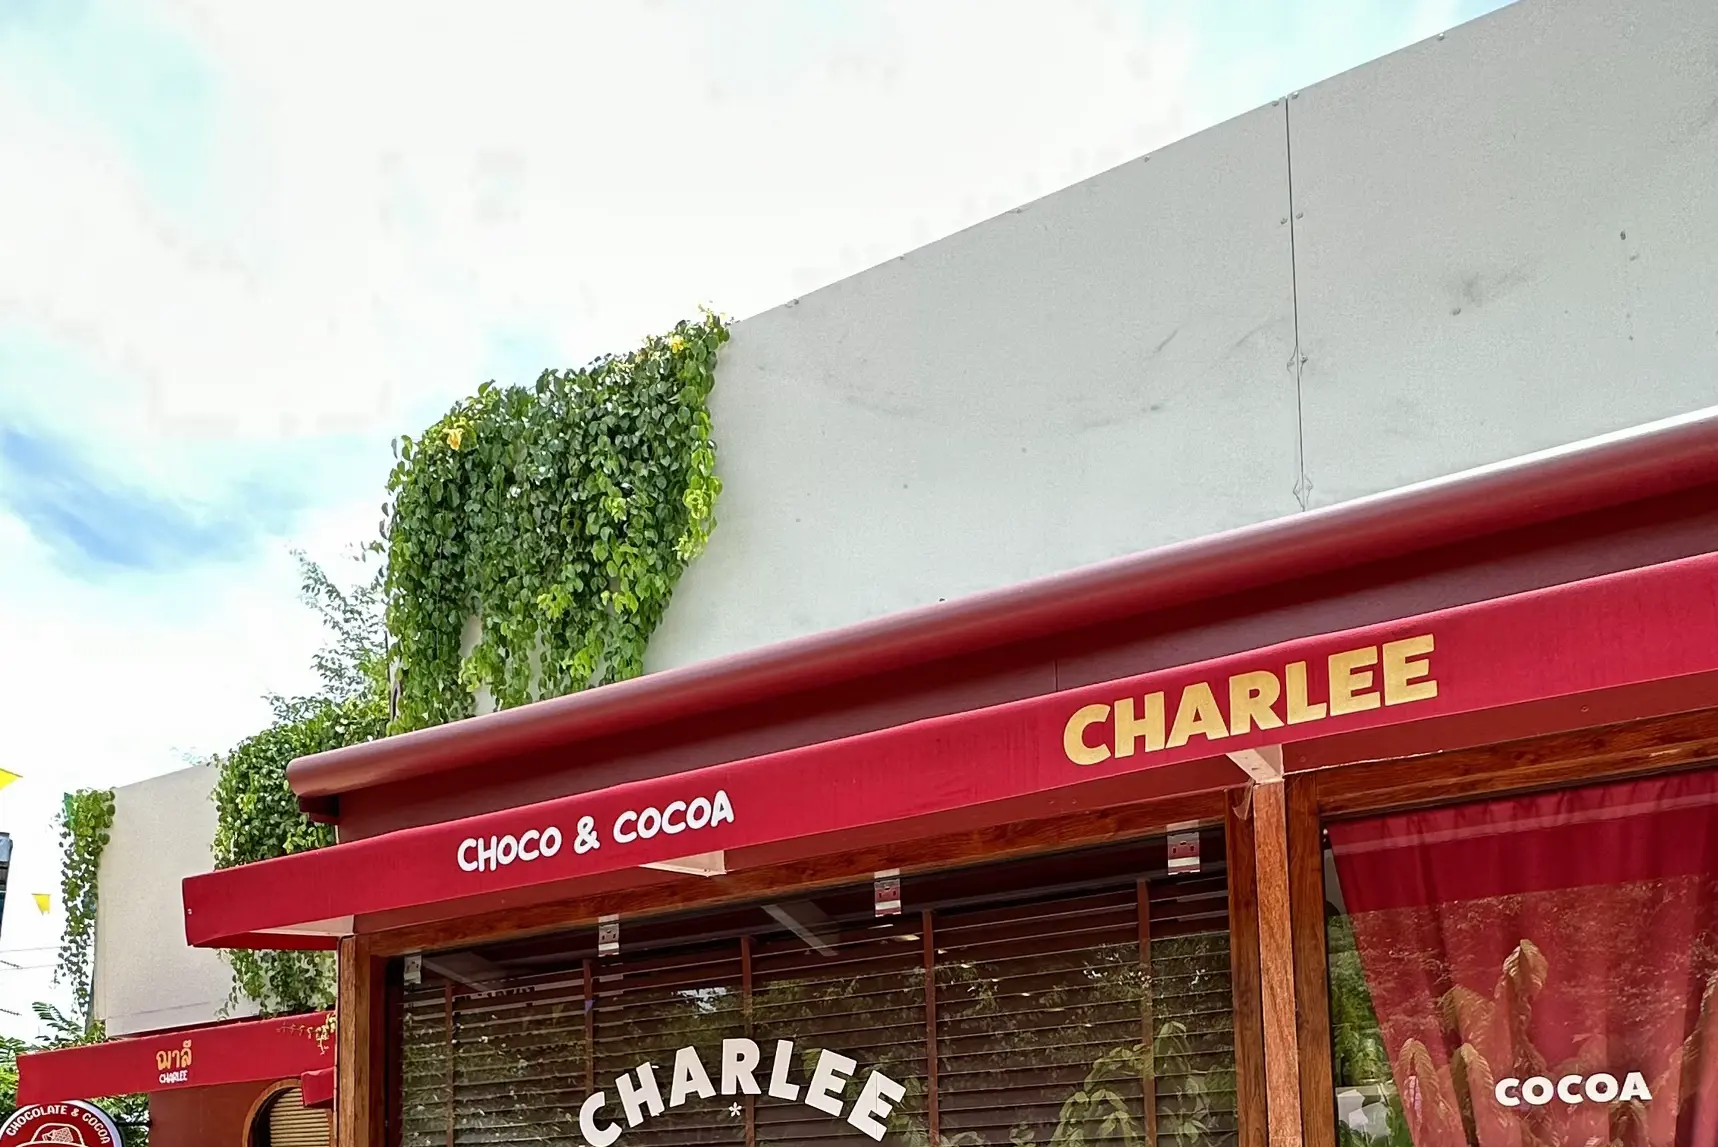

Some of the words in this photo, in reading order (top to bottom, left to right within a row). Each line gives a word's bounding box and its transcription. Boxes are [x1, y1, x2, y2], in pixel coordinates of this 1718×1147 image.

[1063, 634, 1438, 765] CHARLEE
[457, 826, 562, 872] CHOCO
[573, 816, 600, 854] &
[613, 790, 734, 844] COCOA
[5, 1105, 68, 1137] CHOCOLATE
[70, 1107, 80, 1117] &
[81, 1112, 111, 1144] COCOA
[579, 1038, 906, 1147] CHARLEE
[1494, 1071, 1653, 1107] COCOA
